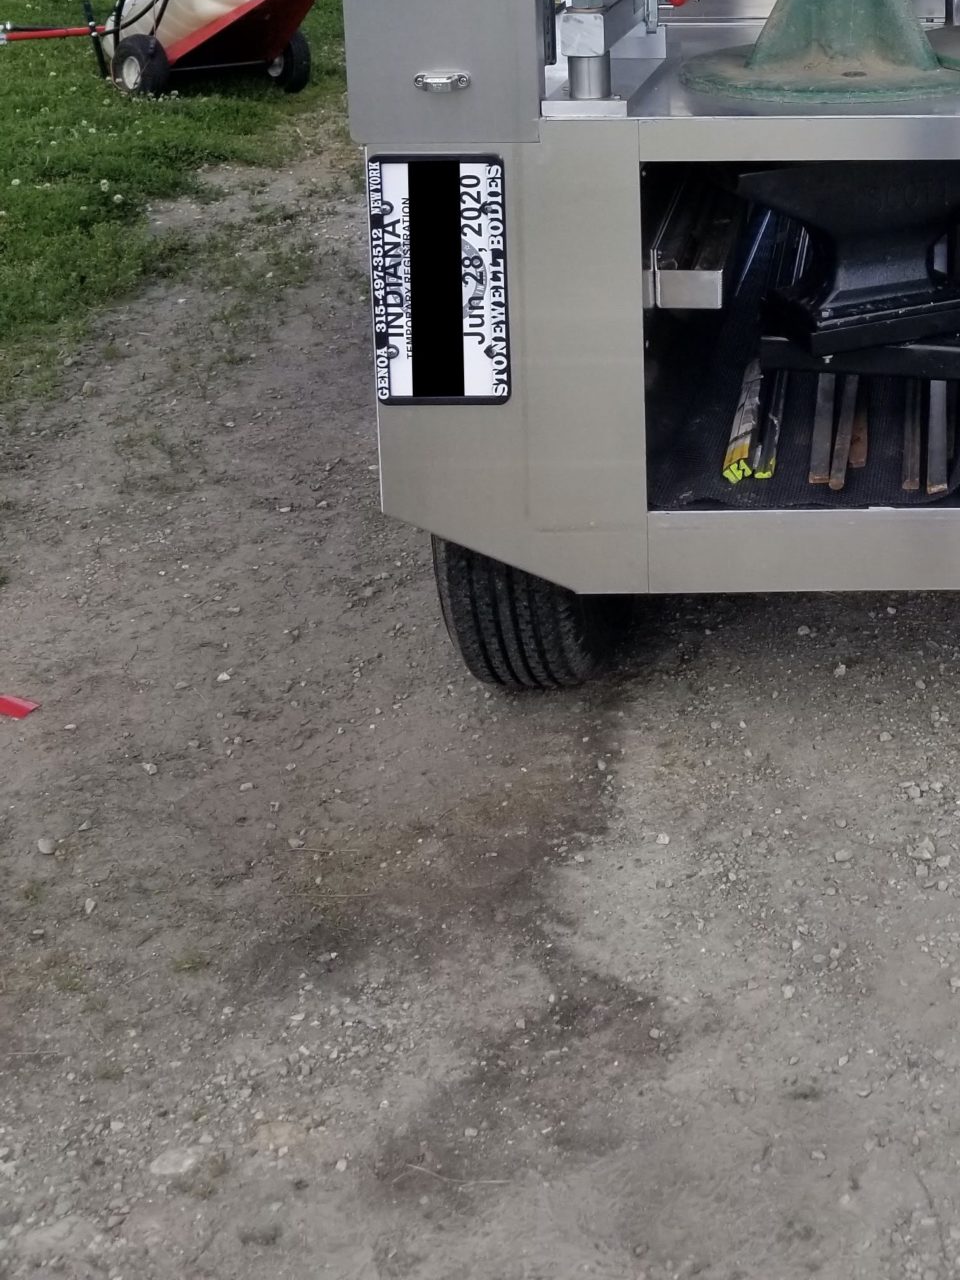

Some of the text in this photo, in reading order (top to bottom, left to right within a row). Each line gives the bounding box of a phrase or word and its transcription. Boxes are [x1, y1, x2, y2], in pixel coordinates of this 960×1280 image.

[459, 174, 482, 237] 2020
[368, 161, 389, 400] GENOA 315-497-3512 NEW YORK
[383, 218, 405, 337] INDIANA
[461, 247, 487, 286] 28,
[485, 164, 509, 397] STONEWELL BODIES
[463, 296, 486, 345] Jun
